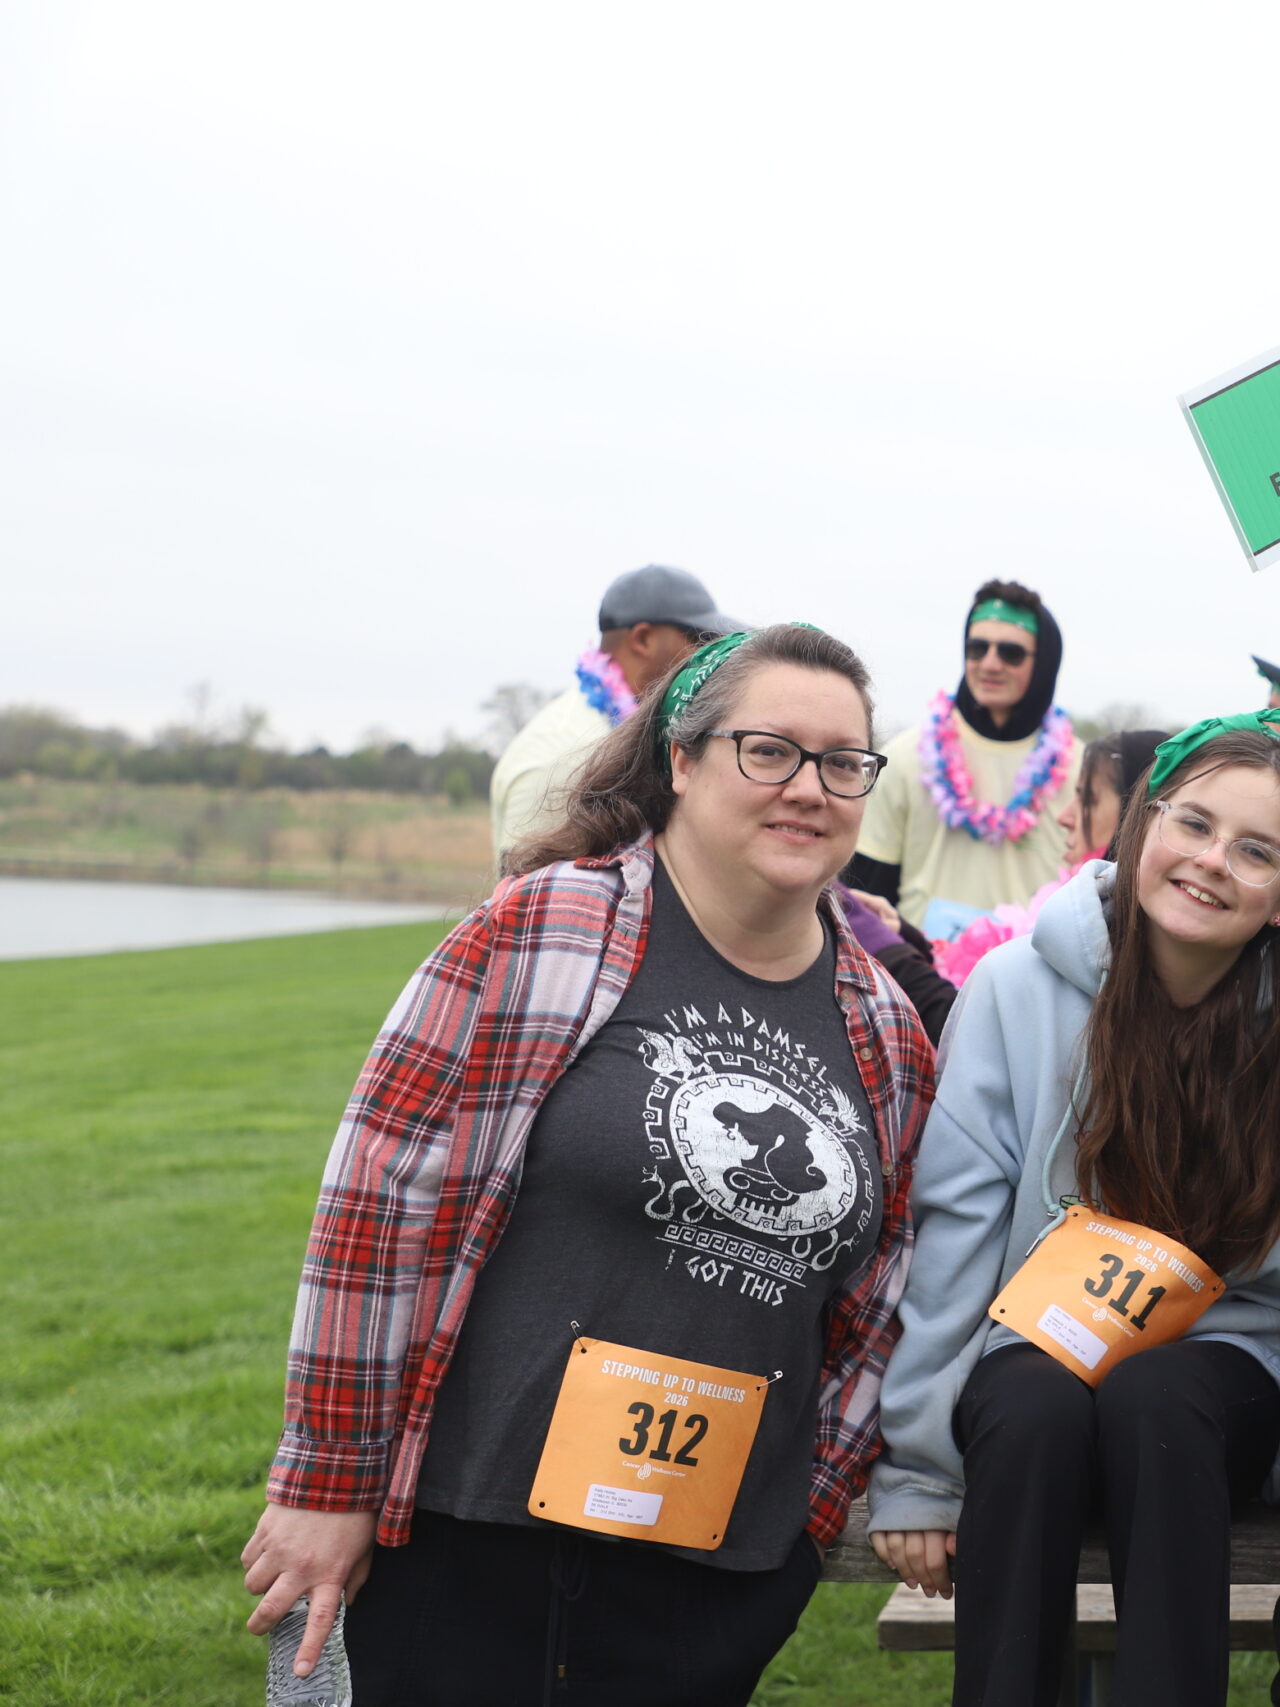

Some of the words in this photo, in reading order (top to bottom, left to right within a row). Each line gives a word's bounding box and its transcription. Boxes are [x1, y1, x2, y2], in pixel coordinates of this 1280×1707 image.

[664, 1004, 707, 1033] I'M
[717, 1002, 732, 1024] A
[741, 1006, 828, 1084] DAMSEL
[691, 1032, 723, 1049] I'M
[727, 1032, 746, 1048] IN
[753, 1037, 828, 1097] DISTRESS
[685, 1255, 734, 1287] GOT
[740, 1270, 787, 1307] THIS
[1085, 1221, 1137, 1246] STEPPING
[1136, 1239, 1153, 1252] UP
[1152, 1246, 1168, 1263] TO
[1167, 1255, 1205, 1293] WELLNESS
[1133, 1253, 1159, 1273] 2026
[1084, 1253, 1167, 1332] 311
[601, 1359, 660, 1385] STEPPING
[663, 1373, 679, 1388] UP
[681, 1377, 696, 1393] TO
[697, 1381, 746, 1404] WELLNESS
[664, 1392, 689, 1407] 2026
[618, 1401, 709, 1467] 312
